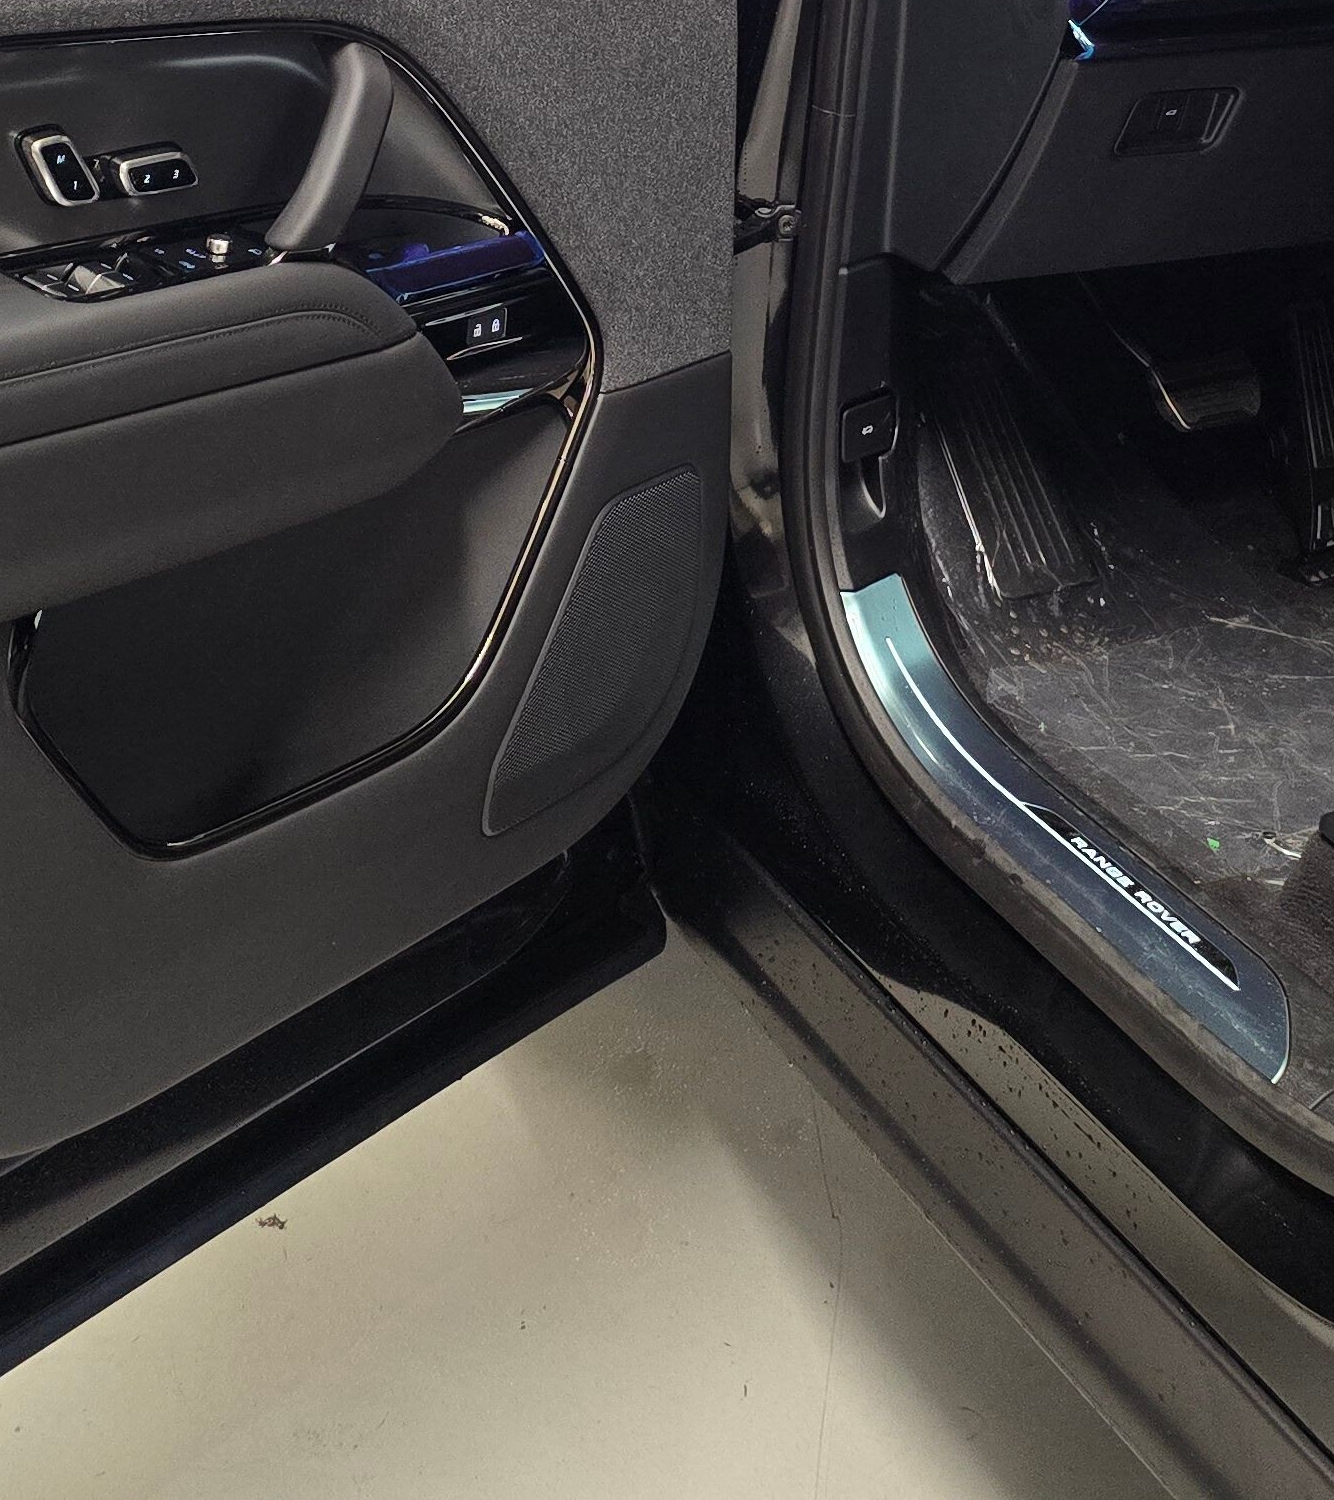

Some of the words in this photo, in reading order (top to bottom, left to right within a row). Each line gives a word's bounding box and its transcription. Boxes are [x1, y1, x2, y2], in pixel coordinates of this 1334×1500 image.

[143, 174, 151, 184] 2
[172, 169, 180, 180] 3
[73, 180, 78, 190] 1
[1070, 835, 1135, 889] RANGE
[1134, 889, 1201, 946] ROVER
